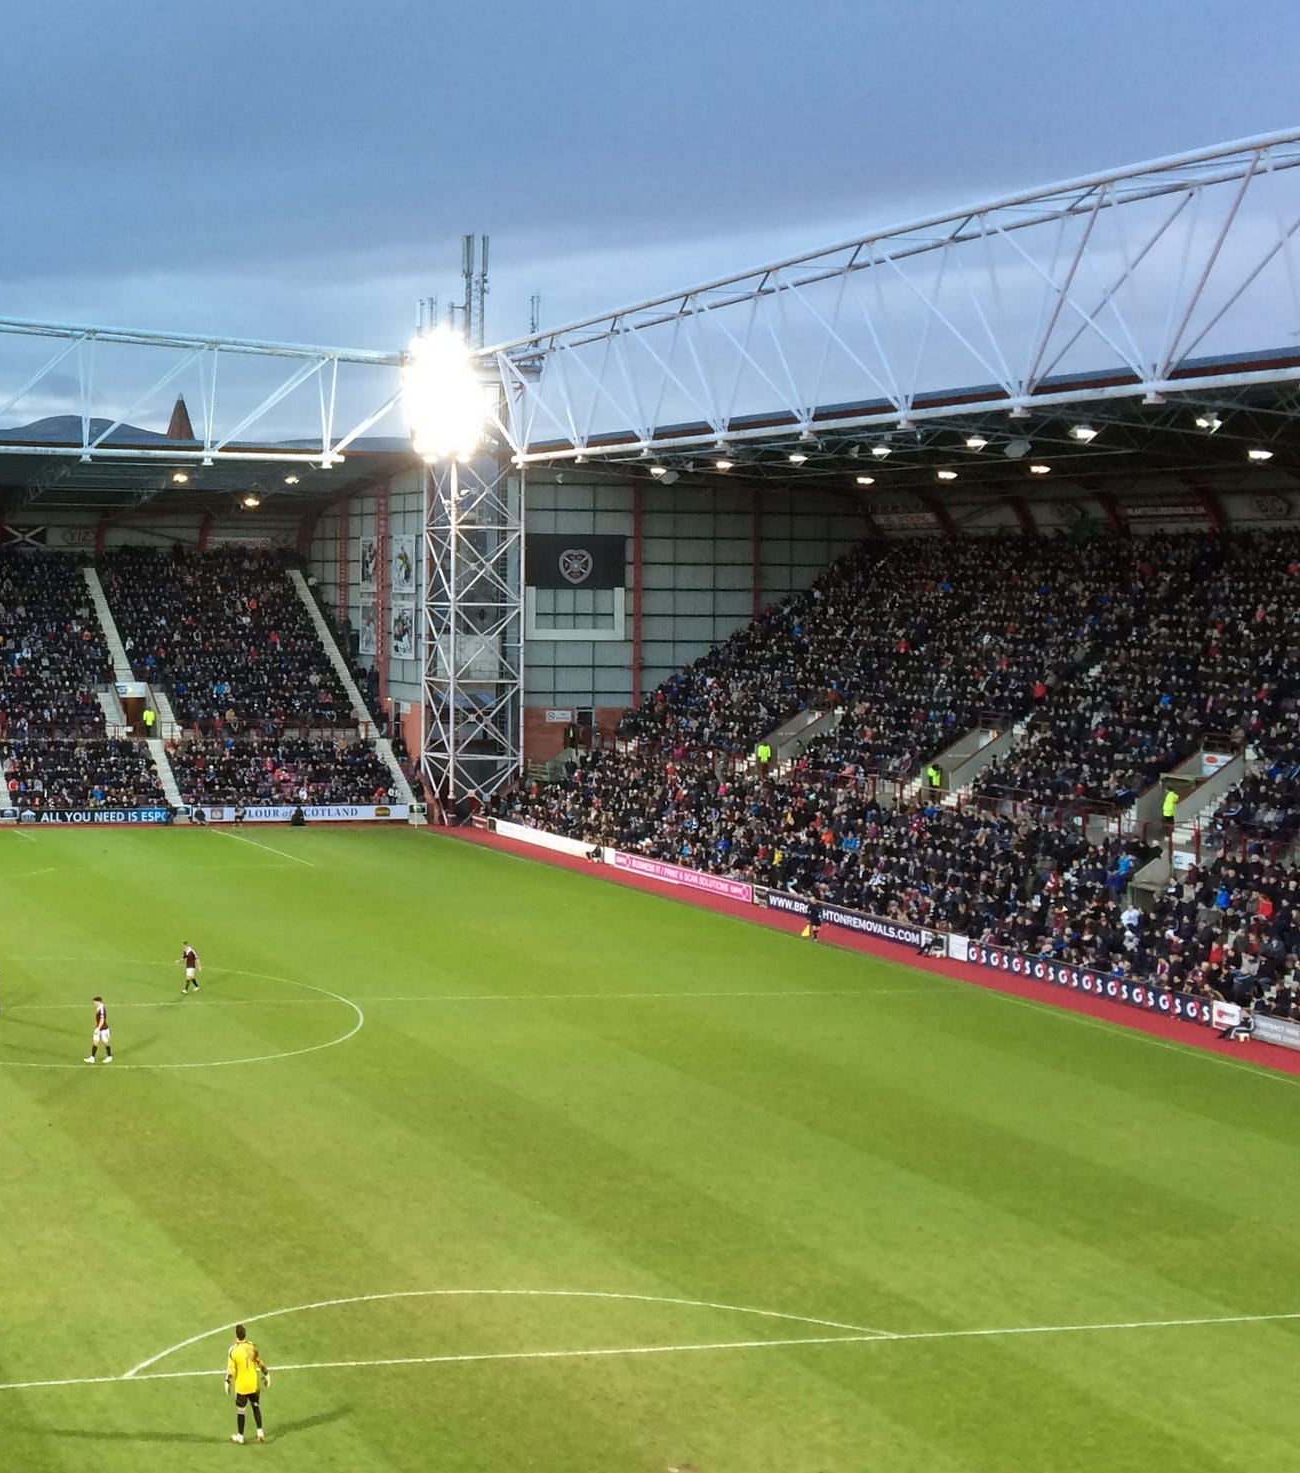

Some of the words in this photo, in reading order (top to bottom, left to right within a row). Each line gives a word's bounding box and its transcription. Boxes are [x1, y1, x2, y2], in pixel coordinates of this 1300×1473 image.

[40, 811, 62, 823] ALL
[65, 811, 91, 822] YOU
[94, 811, 125, 822] NEED
[127, 811, 138, 821] IS
[246, 808, 280, 818] LOUR
[300, 807, 359, 817] COTLAND
[769, 894, 920, 945] WWW.BROHTONREMOVALS.COM
